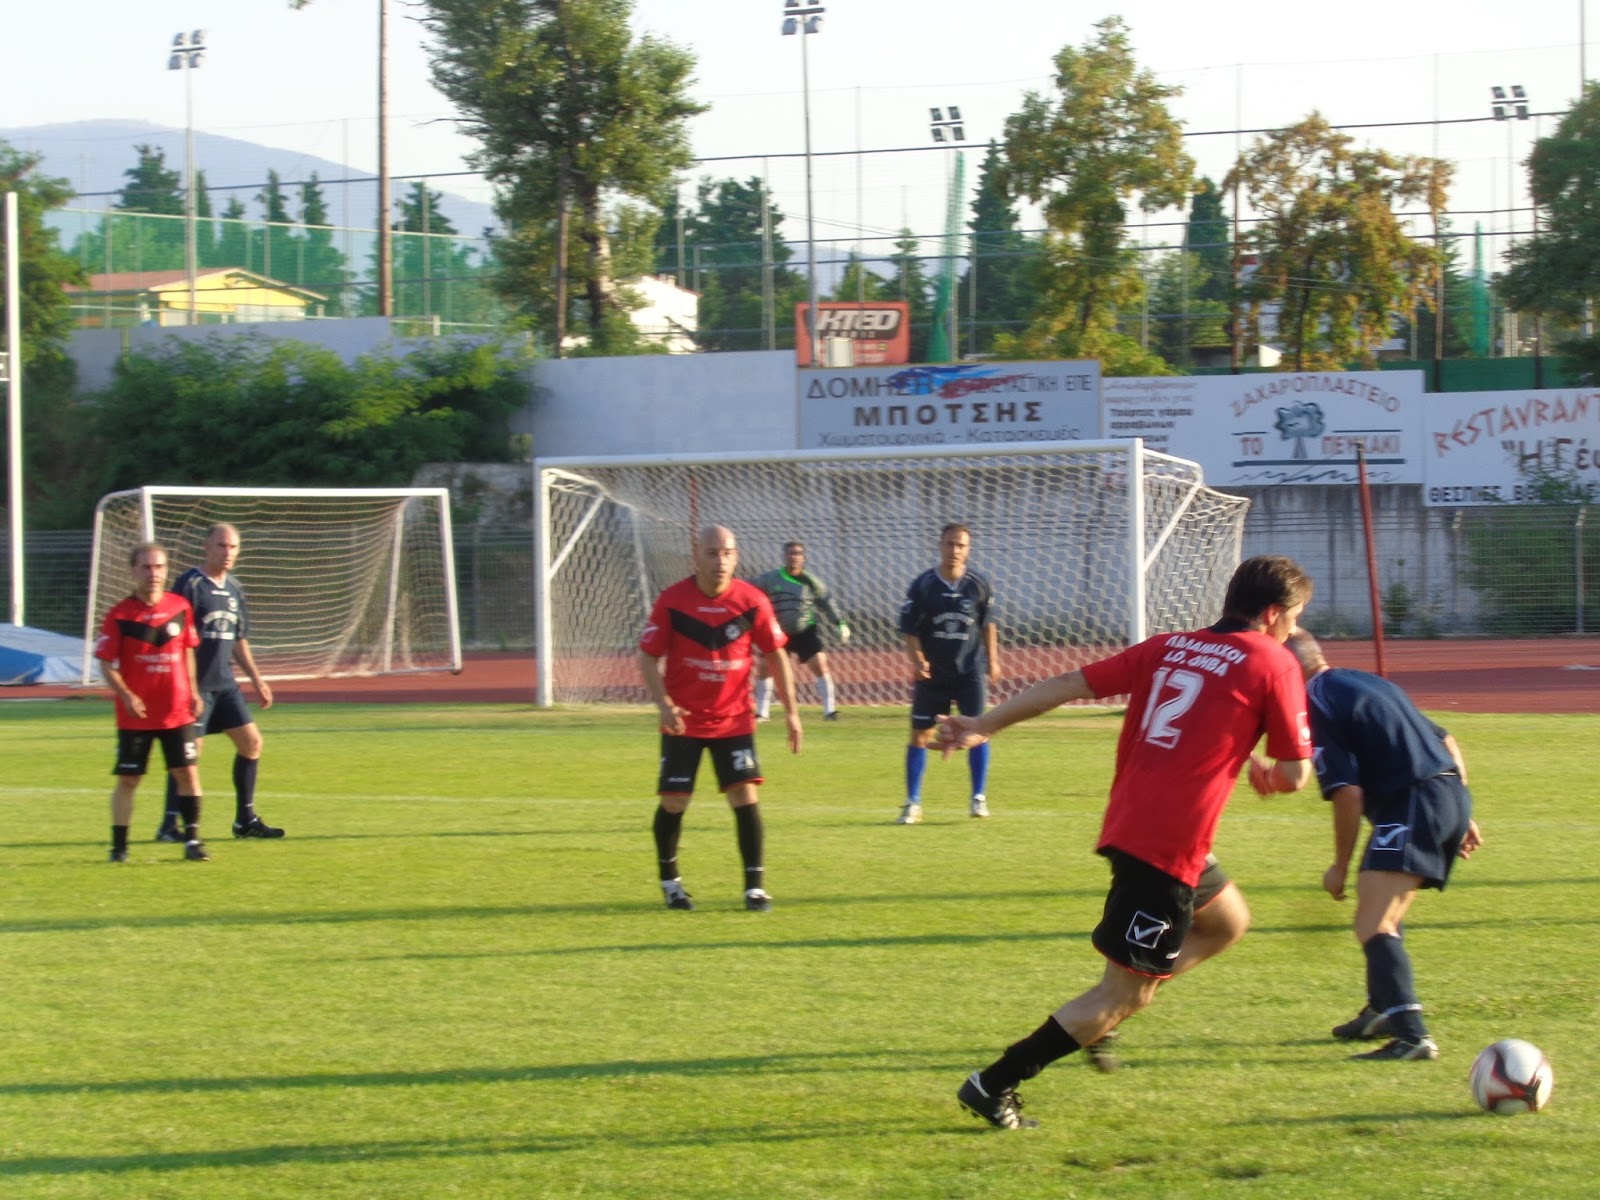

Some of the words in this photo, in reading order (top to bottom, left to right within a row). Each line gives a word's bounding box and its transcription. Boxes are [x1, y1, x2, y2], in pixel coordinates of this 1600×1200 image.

[854, 401, 1043, 426] ΜΠΟΤΣΗΣ
[1241, 437, 1264, 456] ΤΟ
[1141, 666, 1204, 750] 12
